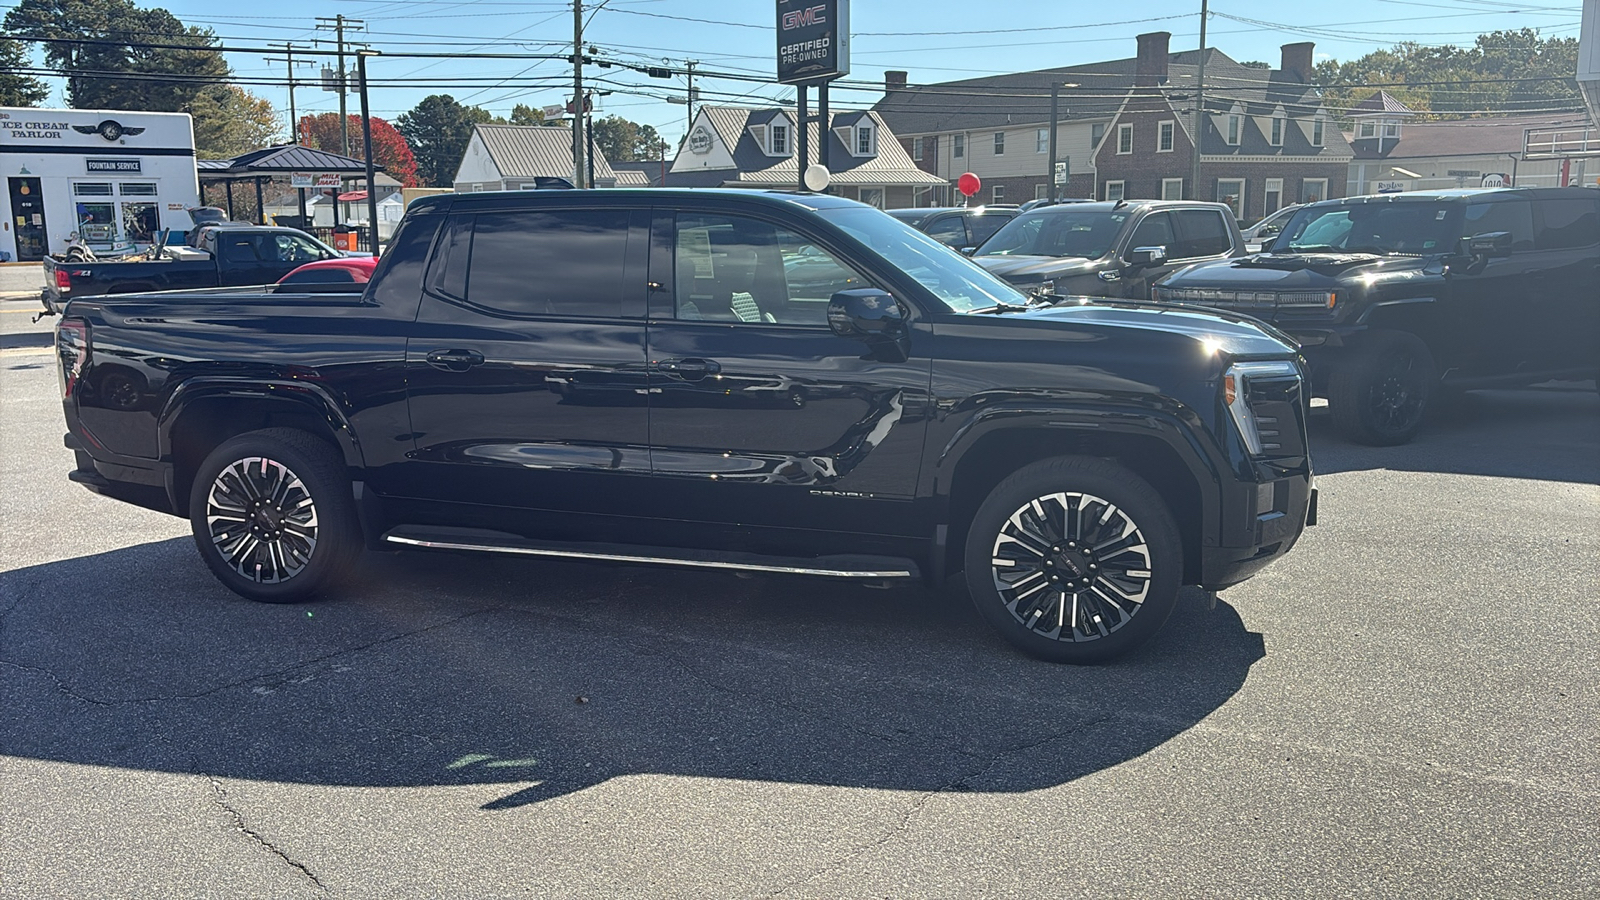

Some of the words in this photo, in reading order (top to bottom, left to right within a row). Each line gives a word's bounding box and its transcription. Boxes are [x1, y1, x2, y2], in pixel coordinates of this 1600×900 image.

[782, 4, 826, 31] GMC
[780, 37, 830, 56] CERTIFIED
[782, 48, 828, 65] PRE-OWNED
[2, 121, 22, 129] ICE
[25, 122, 69, 130] CREAM
[11, 130, 62, 139] PARLOR
[88, 161, 116, 170] FOUNTAIN
[116, 162, 139, 170] SERVICE
[809, 489, 874, 499] DENALI
